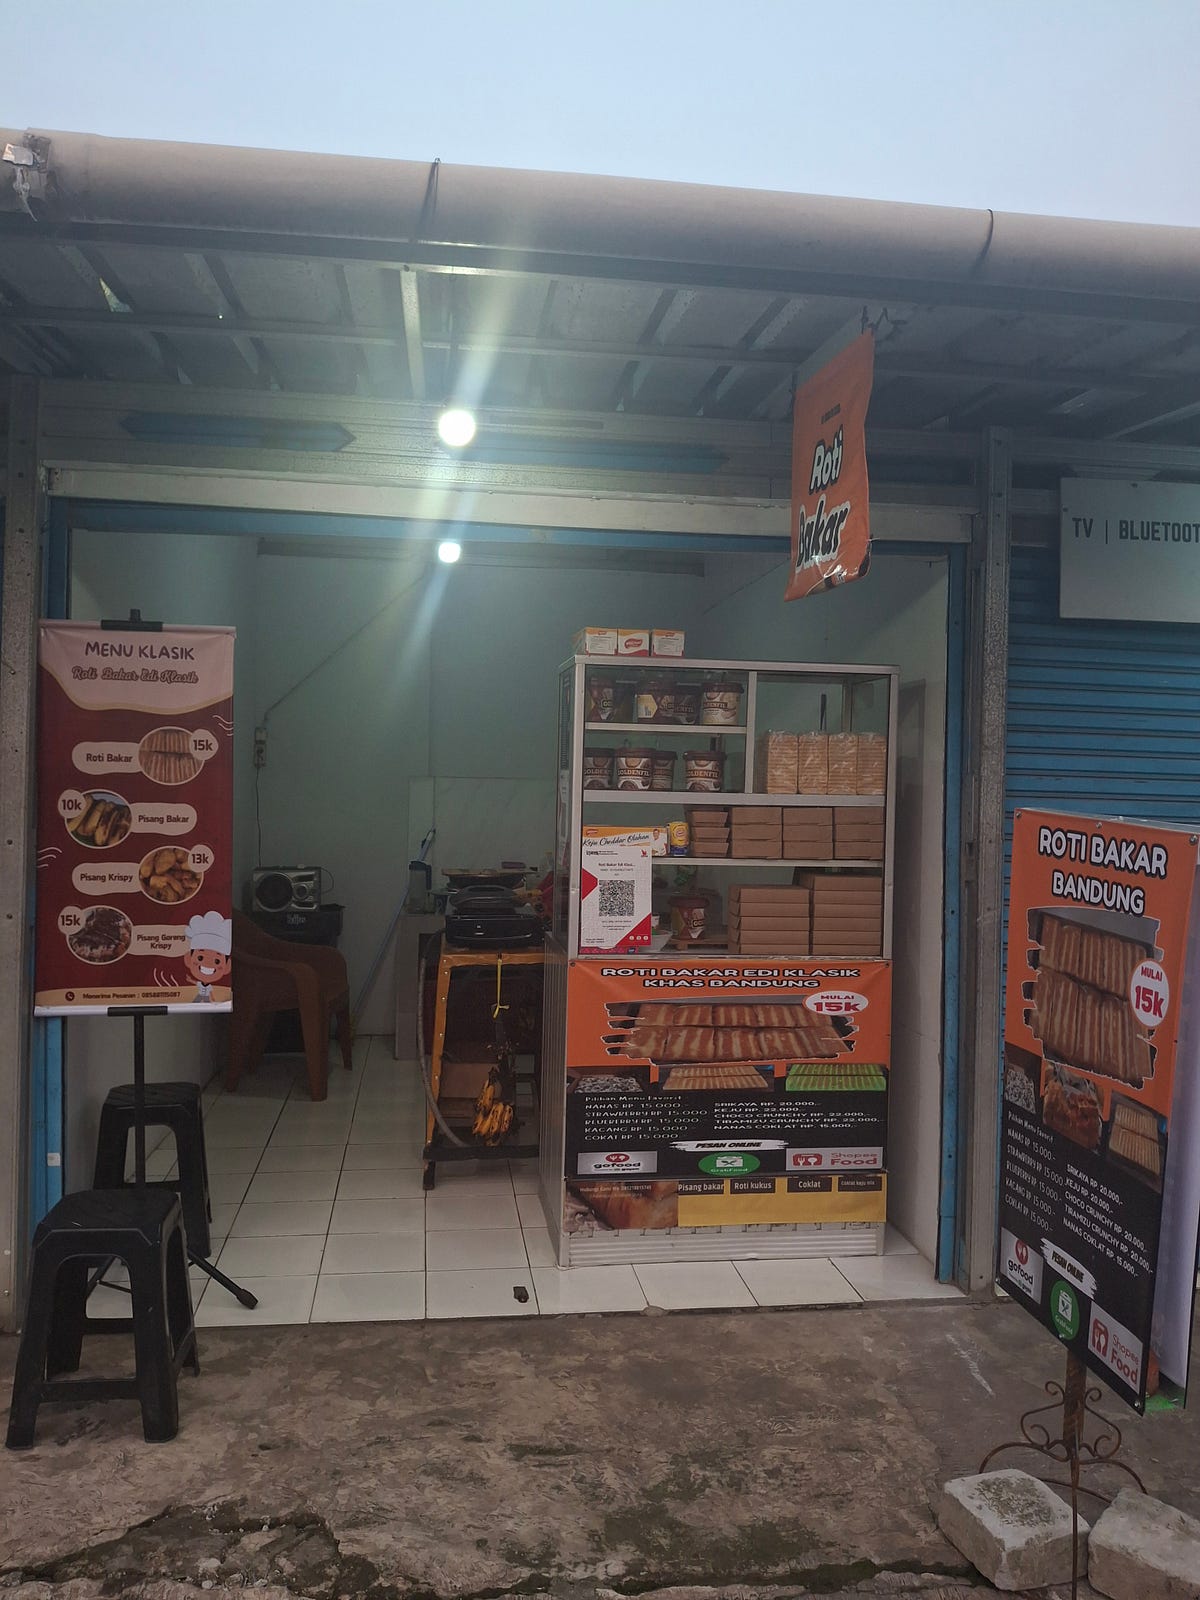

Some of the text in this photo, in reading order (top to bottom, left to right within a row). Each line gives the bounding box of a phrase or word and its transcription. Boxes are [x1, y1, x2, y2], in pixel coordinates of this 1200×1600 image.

[809, 425, 843, 494] Roti
[1072, 517, 1094, 538] TV
[85, 641, 195, 661] MENU KLASIK
[72, 665, 98, 681] Roti
[101, 667, 139, 681] Bakar
[159, 669, 199, 684] Klasik
[193, 740, 213, 752] 15k
[86, 753, 133, 763] Roti Bakar
[62, 800, 82, 811] 10k
[138, 814, 190, 825] Pisang Bakar
[192, 853, 210, 864] 13k
[1039, 826, 1168, 877] ROTI BAKAR
[80, 873, 133, 882] Pisang Krispy
[1052, 871, 1145, 915] BANDUNG
[61, 915, 81, 926] 15k
[136, 934, 186, 942] Pisang Goreng
[150, 942, 172, 950] Krispy
[601, 967, 860, 979] ROTI BAKAR EDI KLASIK
[1141, 966, 1163, 981] MULAI
[643, 979, 820, 989] KHAS BANDUNG
[1007, 1128, 1024, 1144] NANAS
[830, 1157, 878, 1165] Food
[1067, 1163, 1089, 1185] SRIKAYA
[678, 1182, 724, 1191] Pisang bakar
[734, 1181, 772, 1190] Roti kukus
[798, 1180, 821, 1188] Coklat
[1006, 1176, 1026, 1197] KACANG
[1065, 1177, 1081, 1192] KEJU
[1065, 1191, 1085, 1210] CHOCO
[1086, 1204, 1114, 1229] CRUNCHY
[1064, 1203, 1091, 1228] TIRAMIZU
[1091, 1222, 1120, 1248] CRUNCHY
[1063, 1216, 1083, 1237] NANAS
[1083, 1231, 1106, 1253] COKLAT
[1051, 1250, 1067, 1270] PESAN
[1007, 1259, 1034, 1285] gofood
[1112, 1334, 1139, 1366] Shopee
[1110, 1348, 1139, 1385] Food
